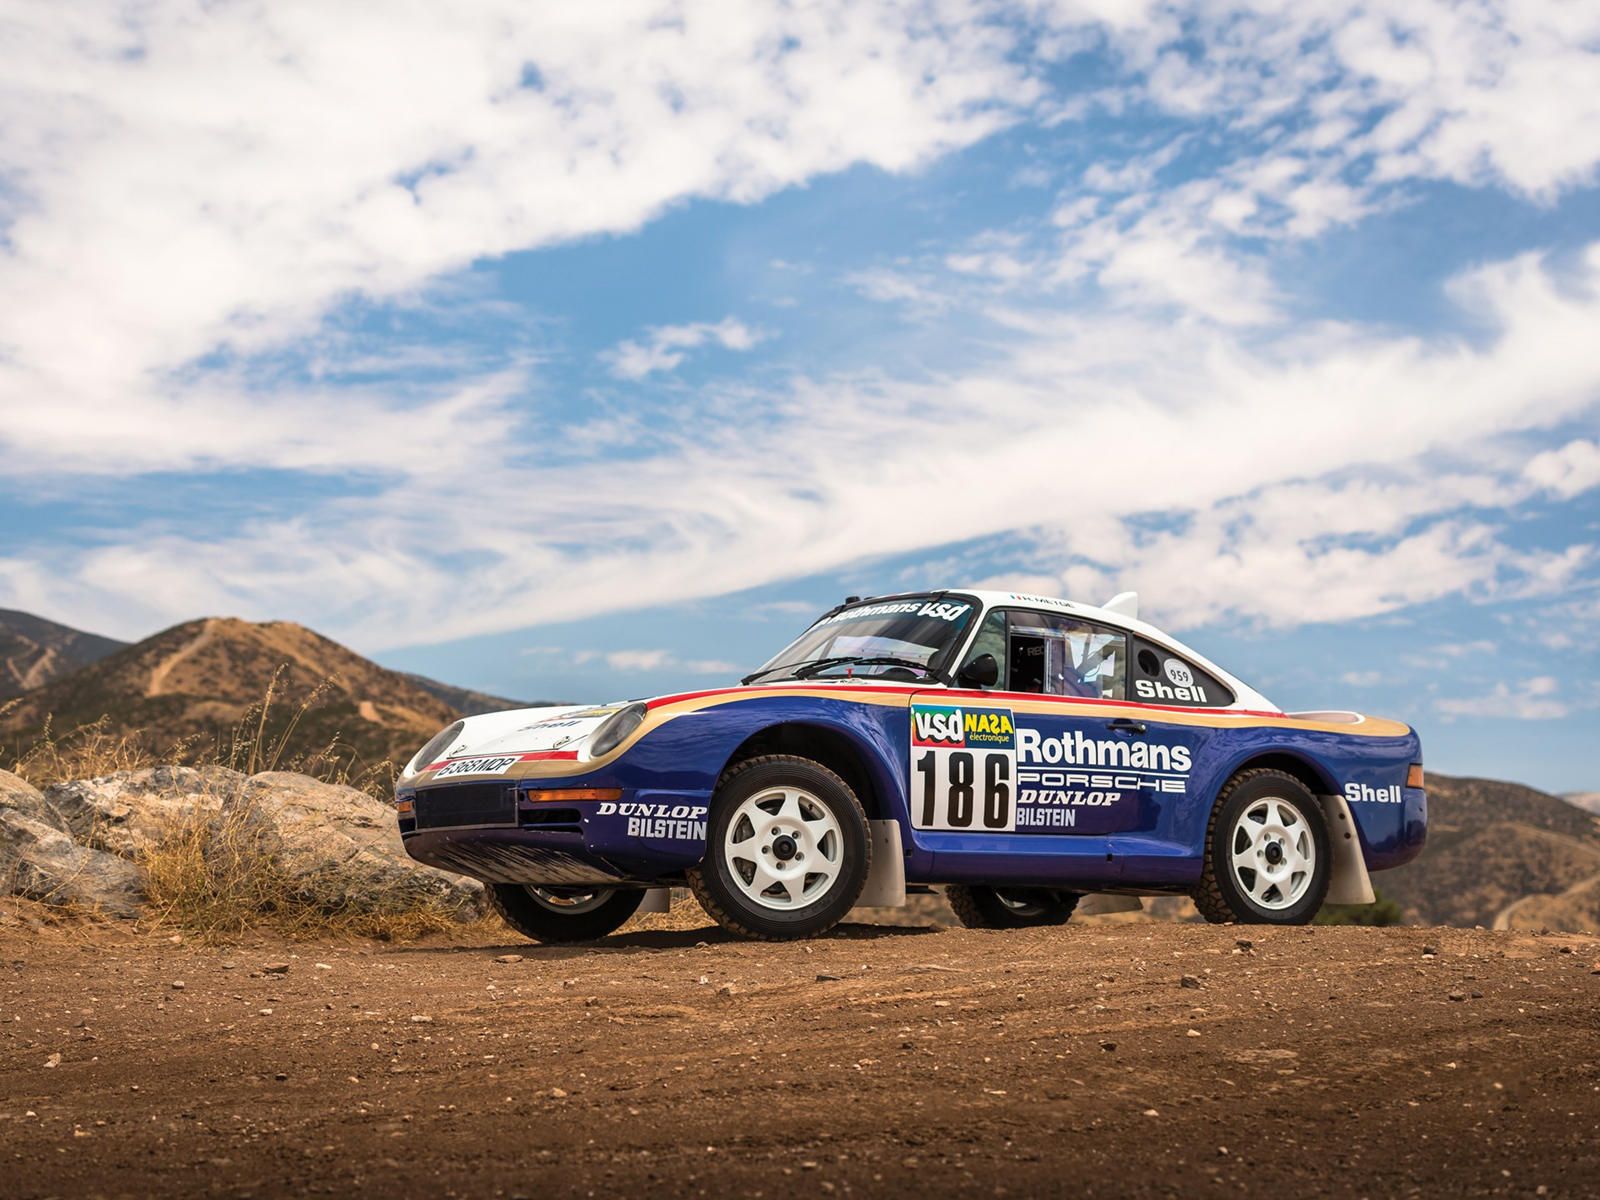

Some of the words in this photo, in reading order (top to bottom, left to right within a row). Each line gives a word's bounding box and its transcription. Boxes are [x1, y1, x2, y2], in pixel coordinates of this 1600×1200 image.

[917, 602, 970, 621] vsd
[1170, 669, 1189, 682] 959
[1135, 679, 1207, 702] Shell
[915, 709, 964, 741] vsd
[969, 731, 1010, 744] électronique
[1016, 728, 1192, 772] Rothmans
[917, 750, 1011, 829] 186
[1017, 772, 1186, 793] PORSCHE
[1344, 782, 1402, 804] Shell
[1017, 789, 1121, 807] DUNLOP
[596, 802, 708, 819] DUNLOP
[1016, 807, 1076, 827] BILSTEIN
[627, 817, 707, 841] BILSTEIN
